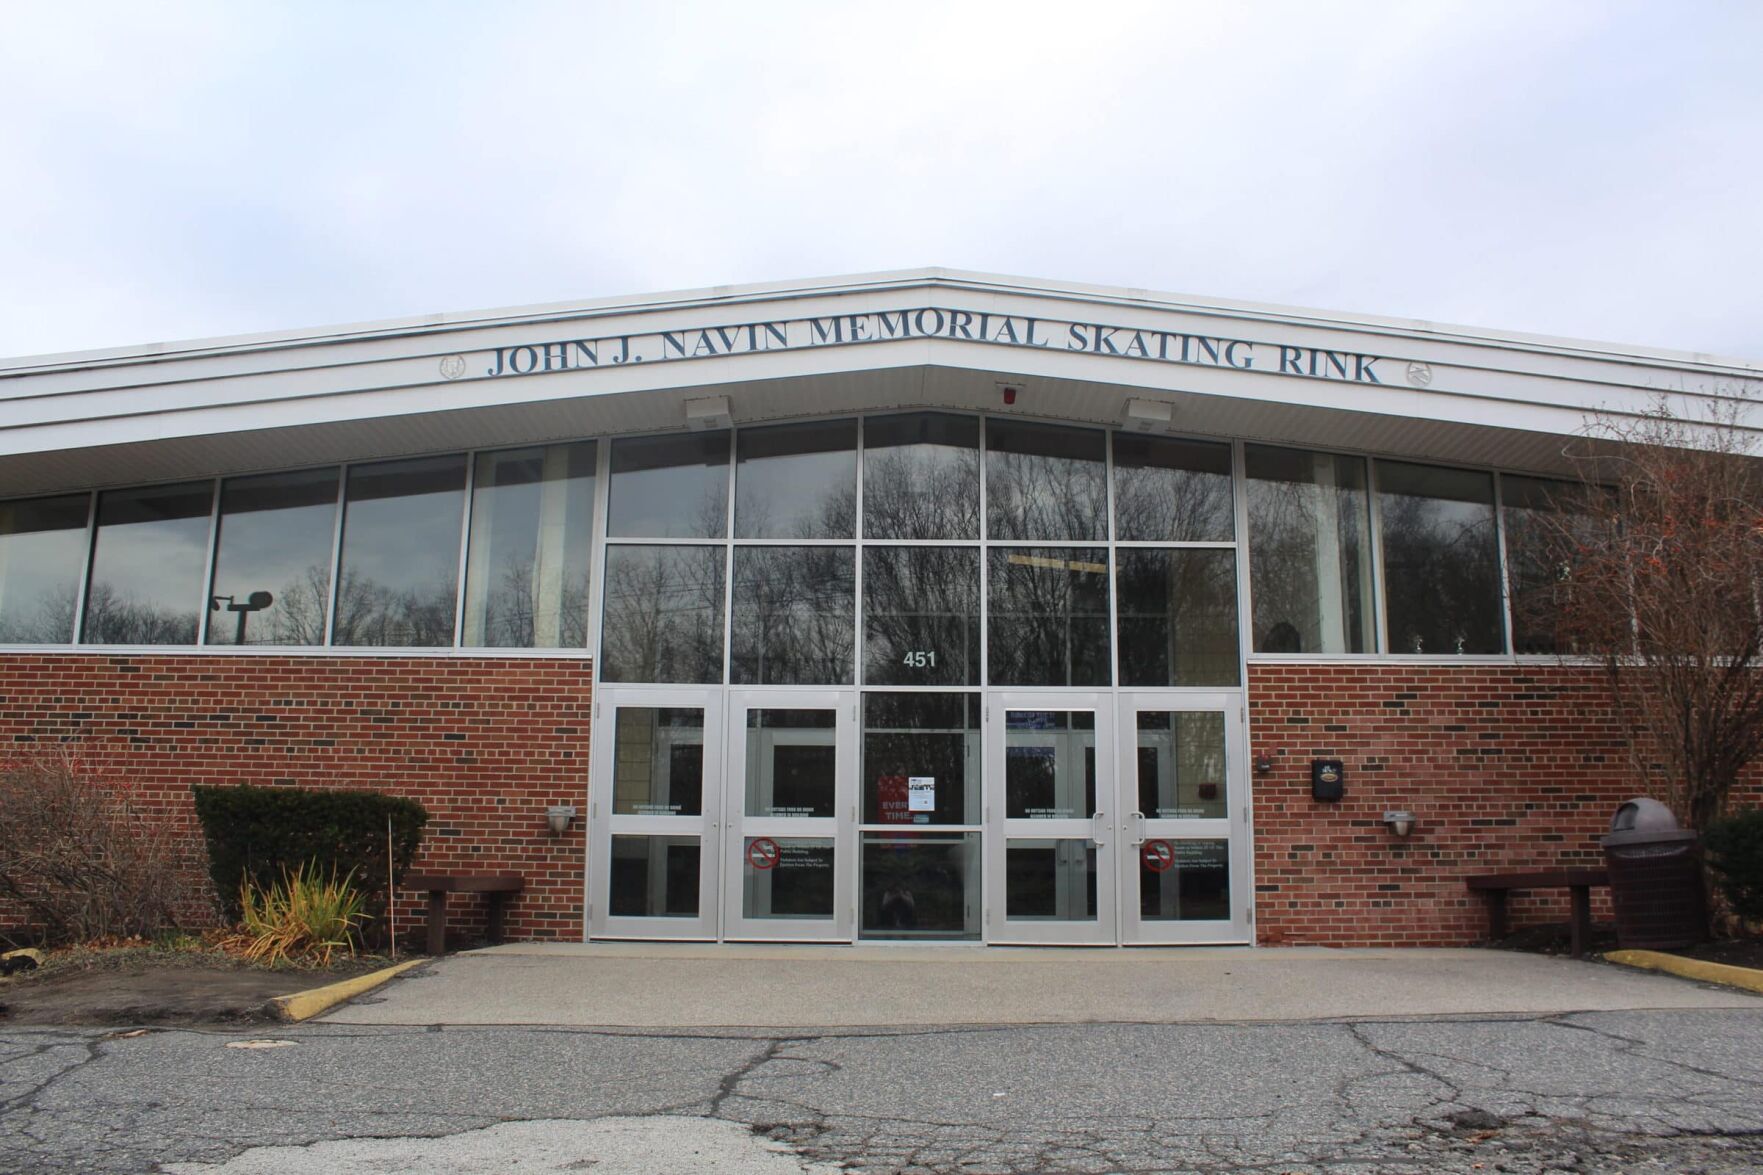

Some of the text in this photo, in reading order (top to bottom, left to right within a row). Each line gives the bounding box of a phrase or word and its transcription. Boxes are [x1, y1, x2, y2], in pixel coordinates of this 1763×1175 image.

[488, 307, 1382, 384] JOHN J. NAVIN MEMORIAL SKATING RINK
[903, 651, 935, 667] 451
